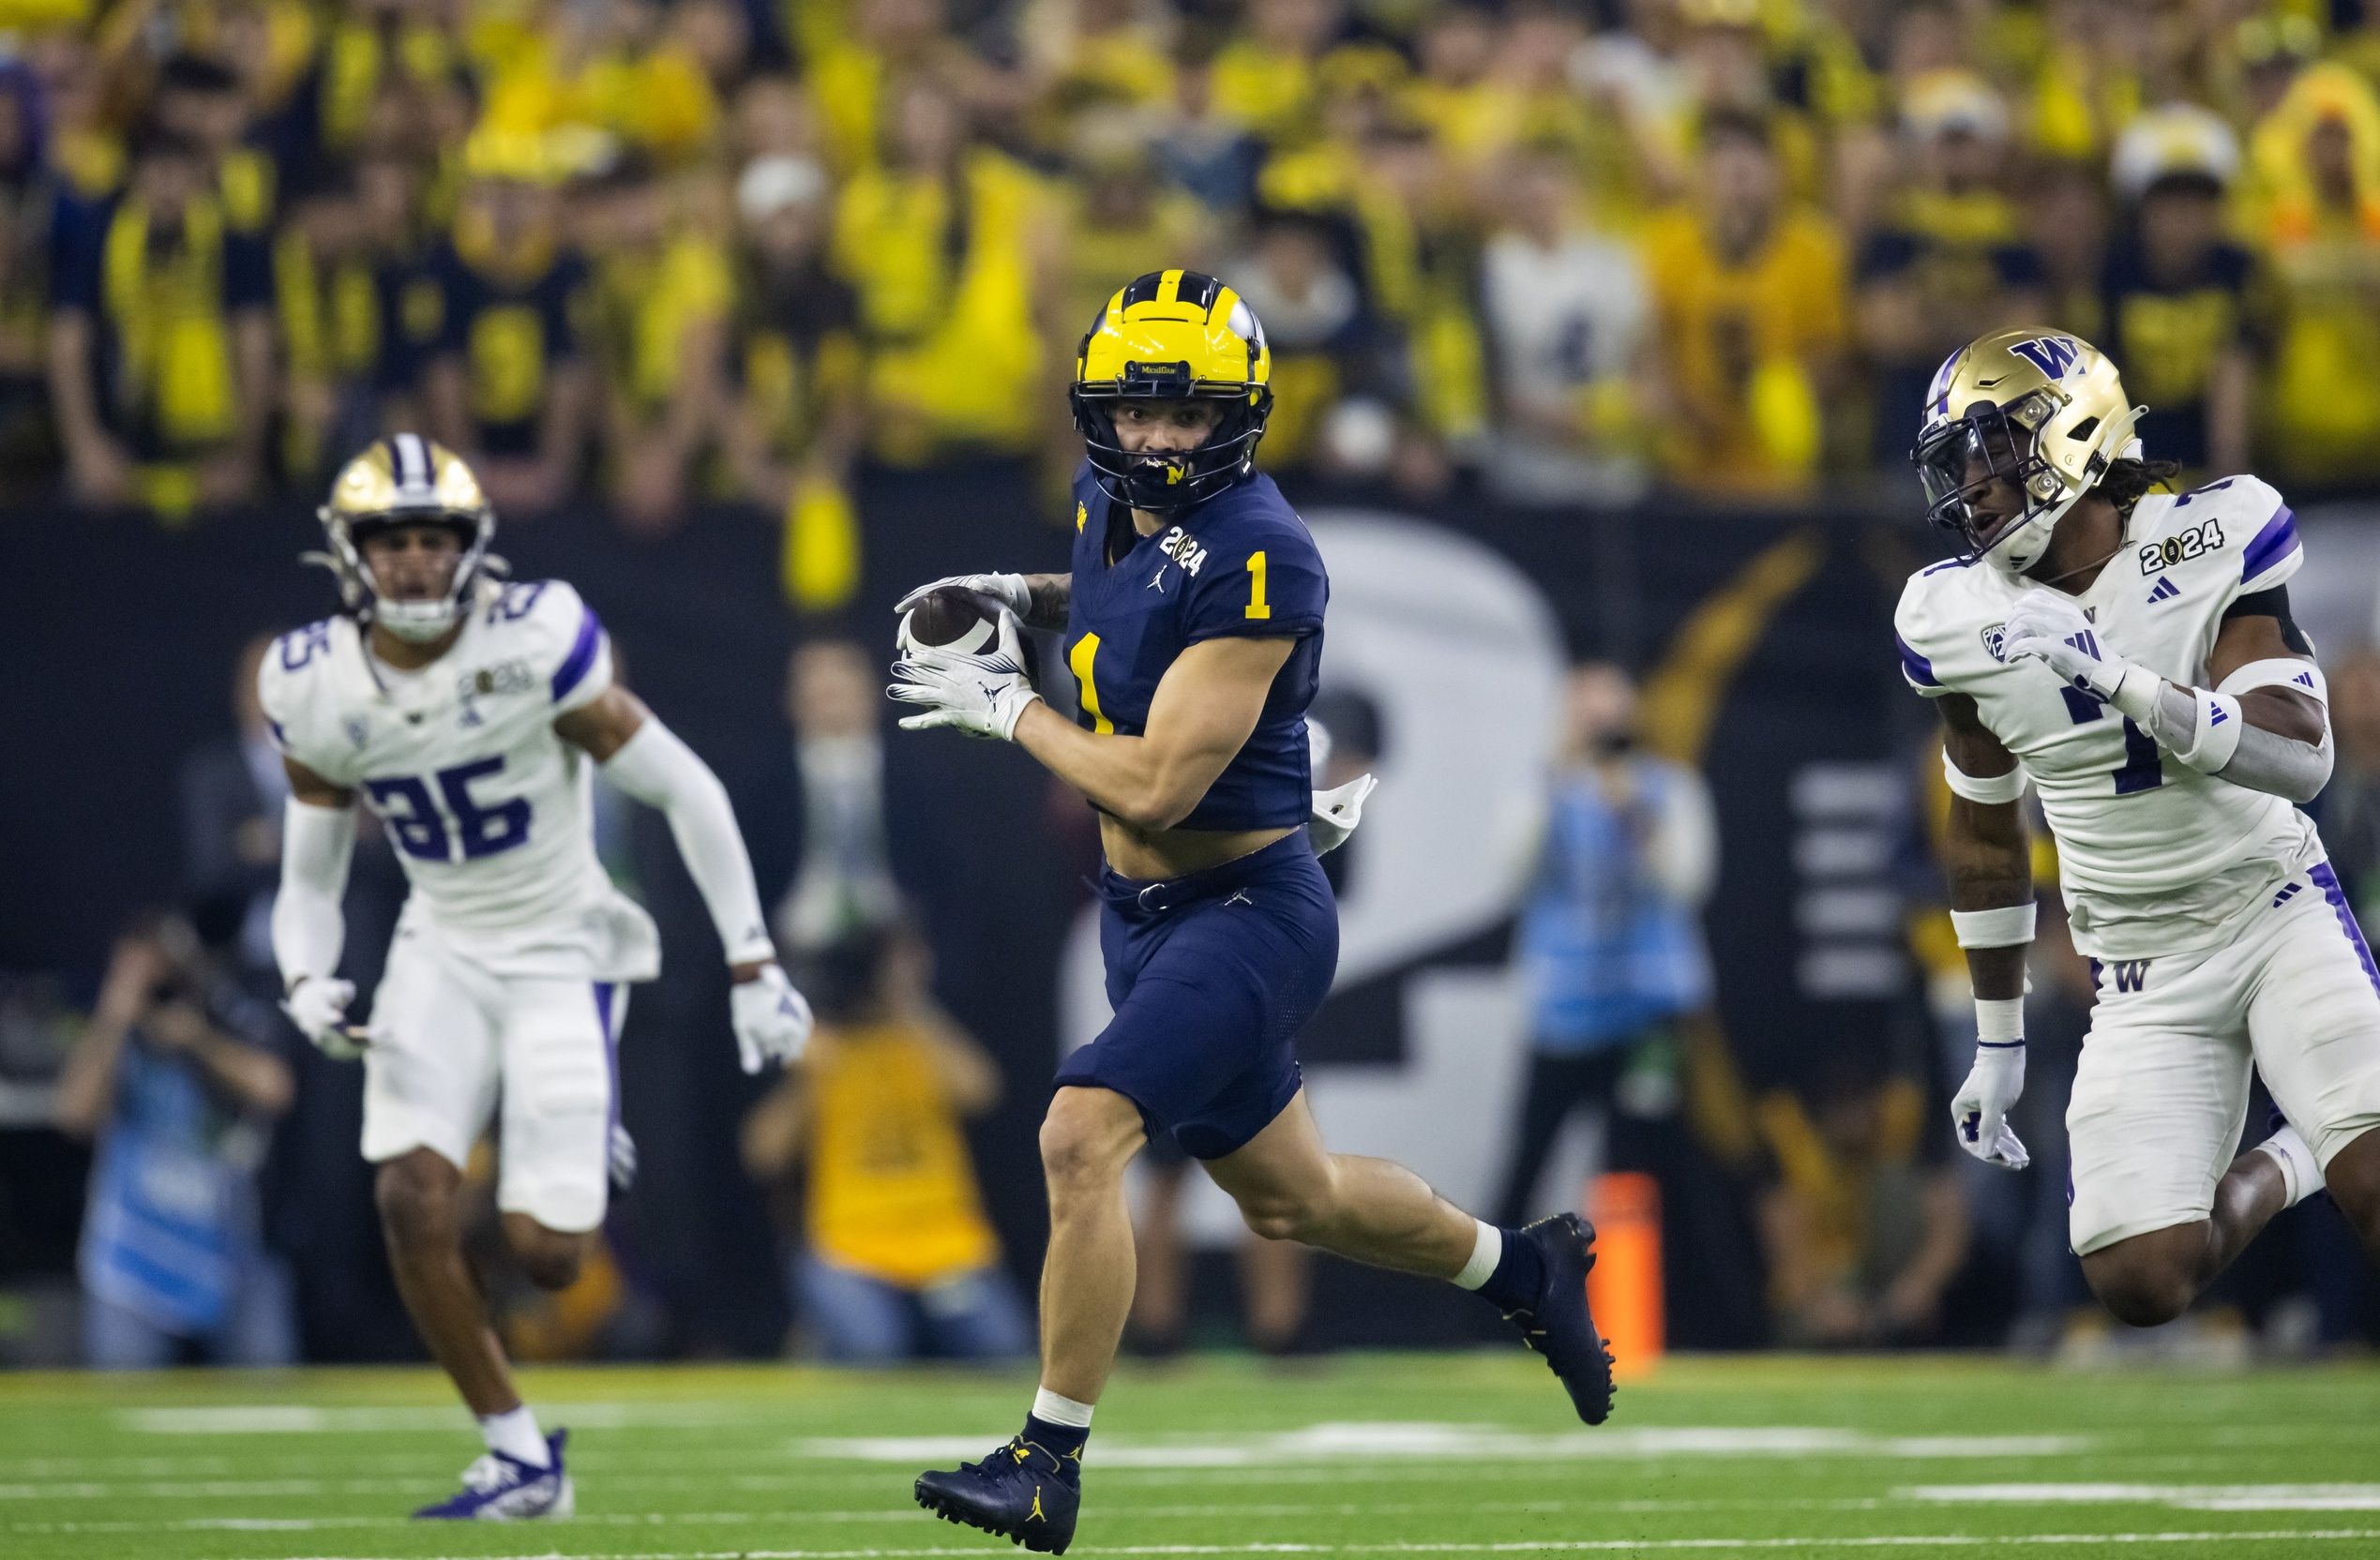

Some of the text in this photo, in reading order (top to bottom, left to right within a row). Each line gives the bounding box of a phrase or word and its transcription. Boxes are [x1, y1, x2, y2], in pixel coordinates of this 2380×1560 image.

[2007, 337, 2079, 381] W
[1159, 526, 1208, 578] 2024
[2139, 518, 2225, 577] 2024
[1245, 551, 1271, 619] 1
[1070, 632, 1114, 735] 1
[2113, 960, 2151, 993] W
